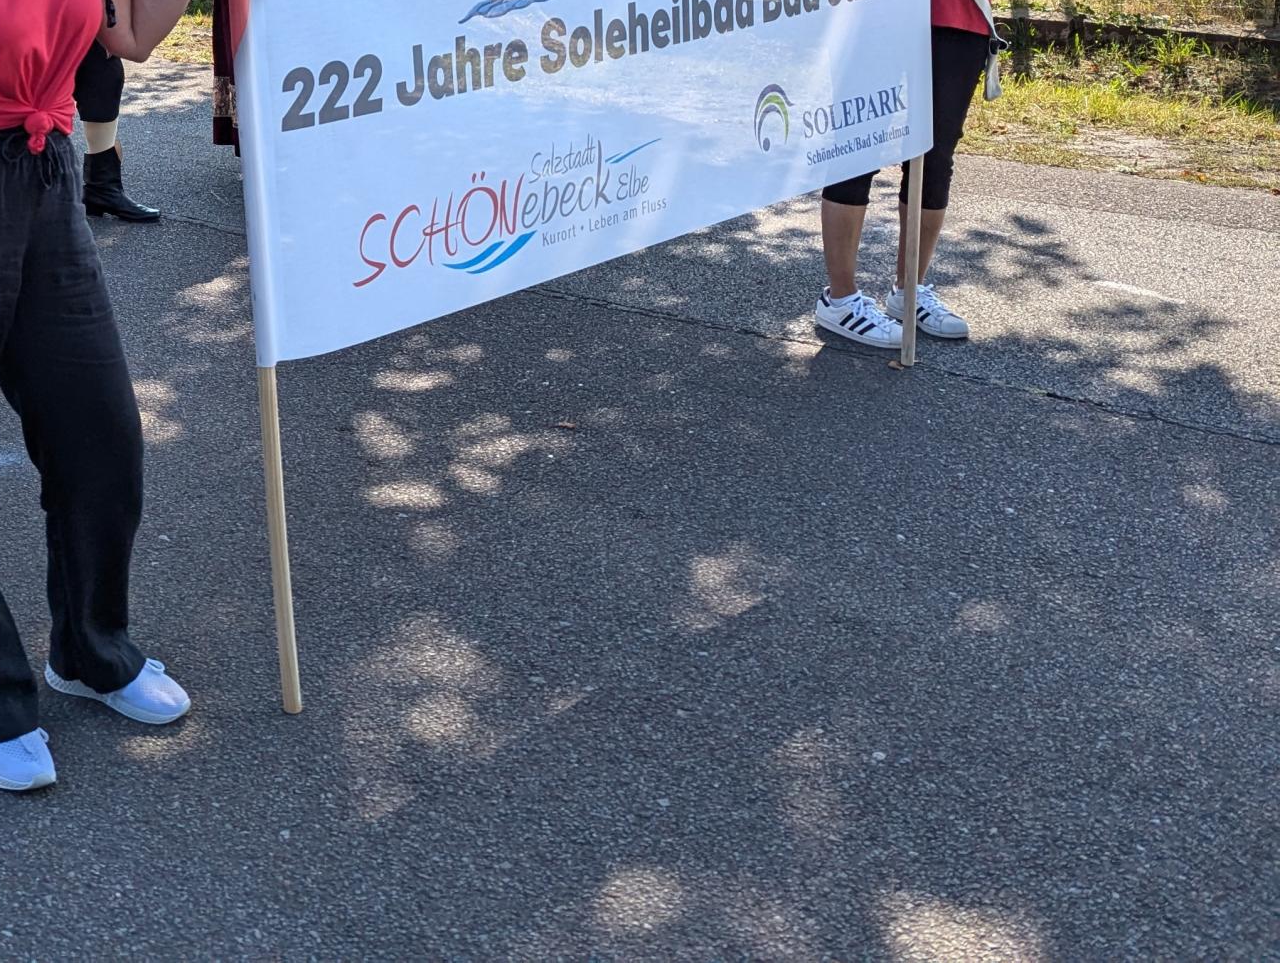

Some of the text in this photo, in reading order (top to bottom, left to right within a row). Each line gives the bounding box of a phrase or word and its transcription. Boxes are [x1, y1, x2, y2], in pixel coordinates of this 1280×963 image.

[281, 53, 384, 133] 222
[395, 35, 529, 107] Jahre
[802, 84, 908, 139] SOLEPARK
[528, 133, 596, 184] Salzstadt
[806, 135, 872, 166] Schönebeck/Bad
[616, 164, 650, 201] Elbe
[541, 197, 667, 247] Kurort Leben am Fluss
